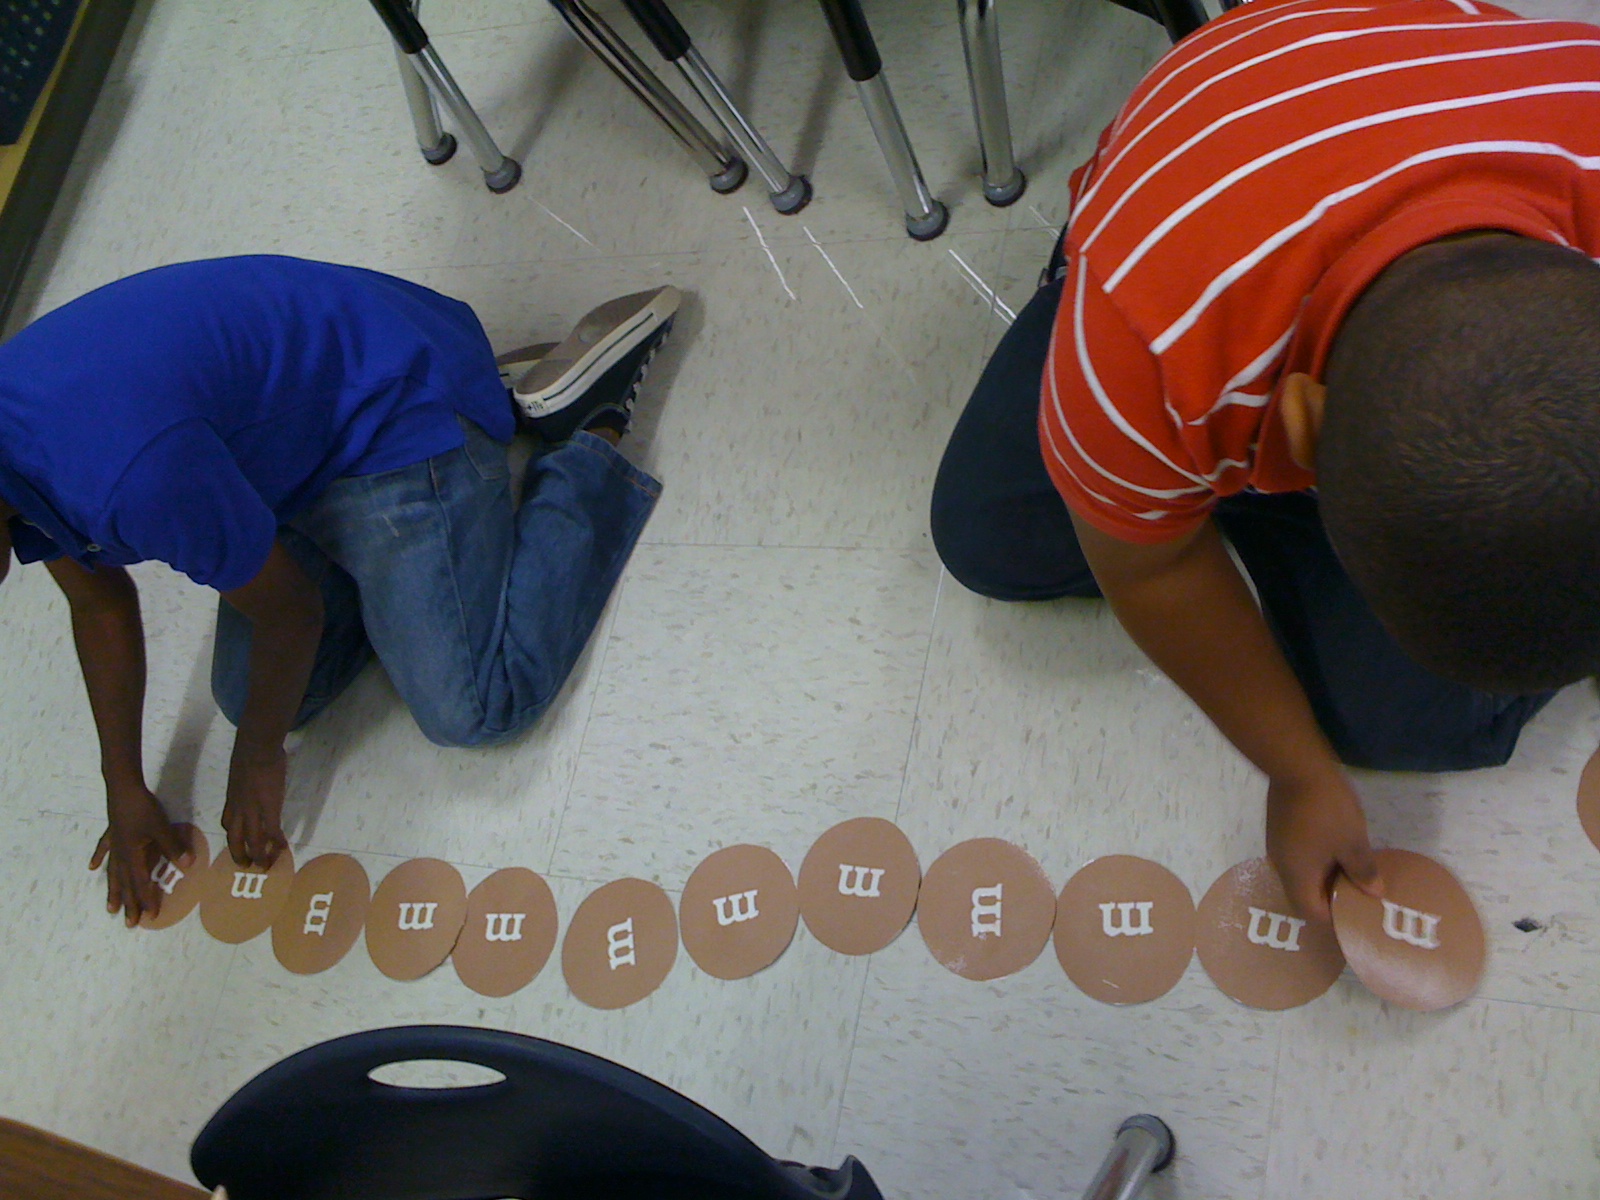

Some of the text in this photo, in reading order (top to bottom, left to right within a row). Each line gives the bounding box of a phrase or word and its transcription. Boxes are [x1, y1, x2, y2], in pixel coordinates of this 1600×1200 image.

[231, 872, 268, 898] m
[838, 864, 885, 897] m
[303, 892, 332, 935] m
[398, 902, 438, 929] m
[712, 889, 761, 925] m
[970, 884, 1003, 940] m
[1098, 902, 1154, 936] m
[1382, 900, 1440, 949] m
[485, 913, 526, 941] m
[607, 917, 637, 969] m
[1248, 906, 1306, 951] m
